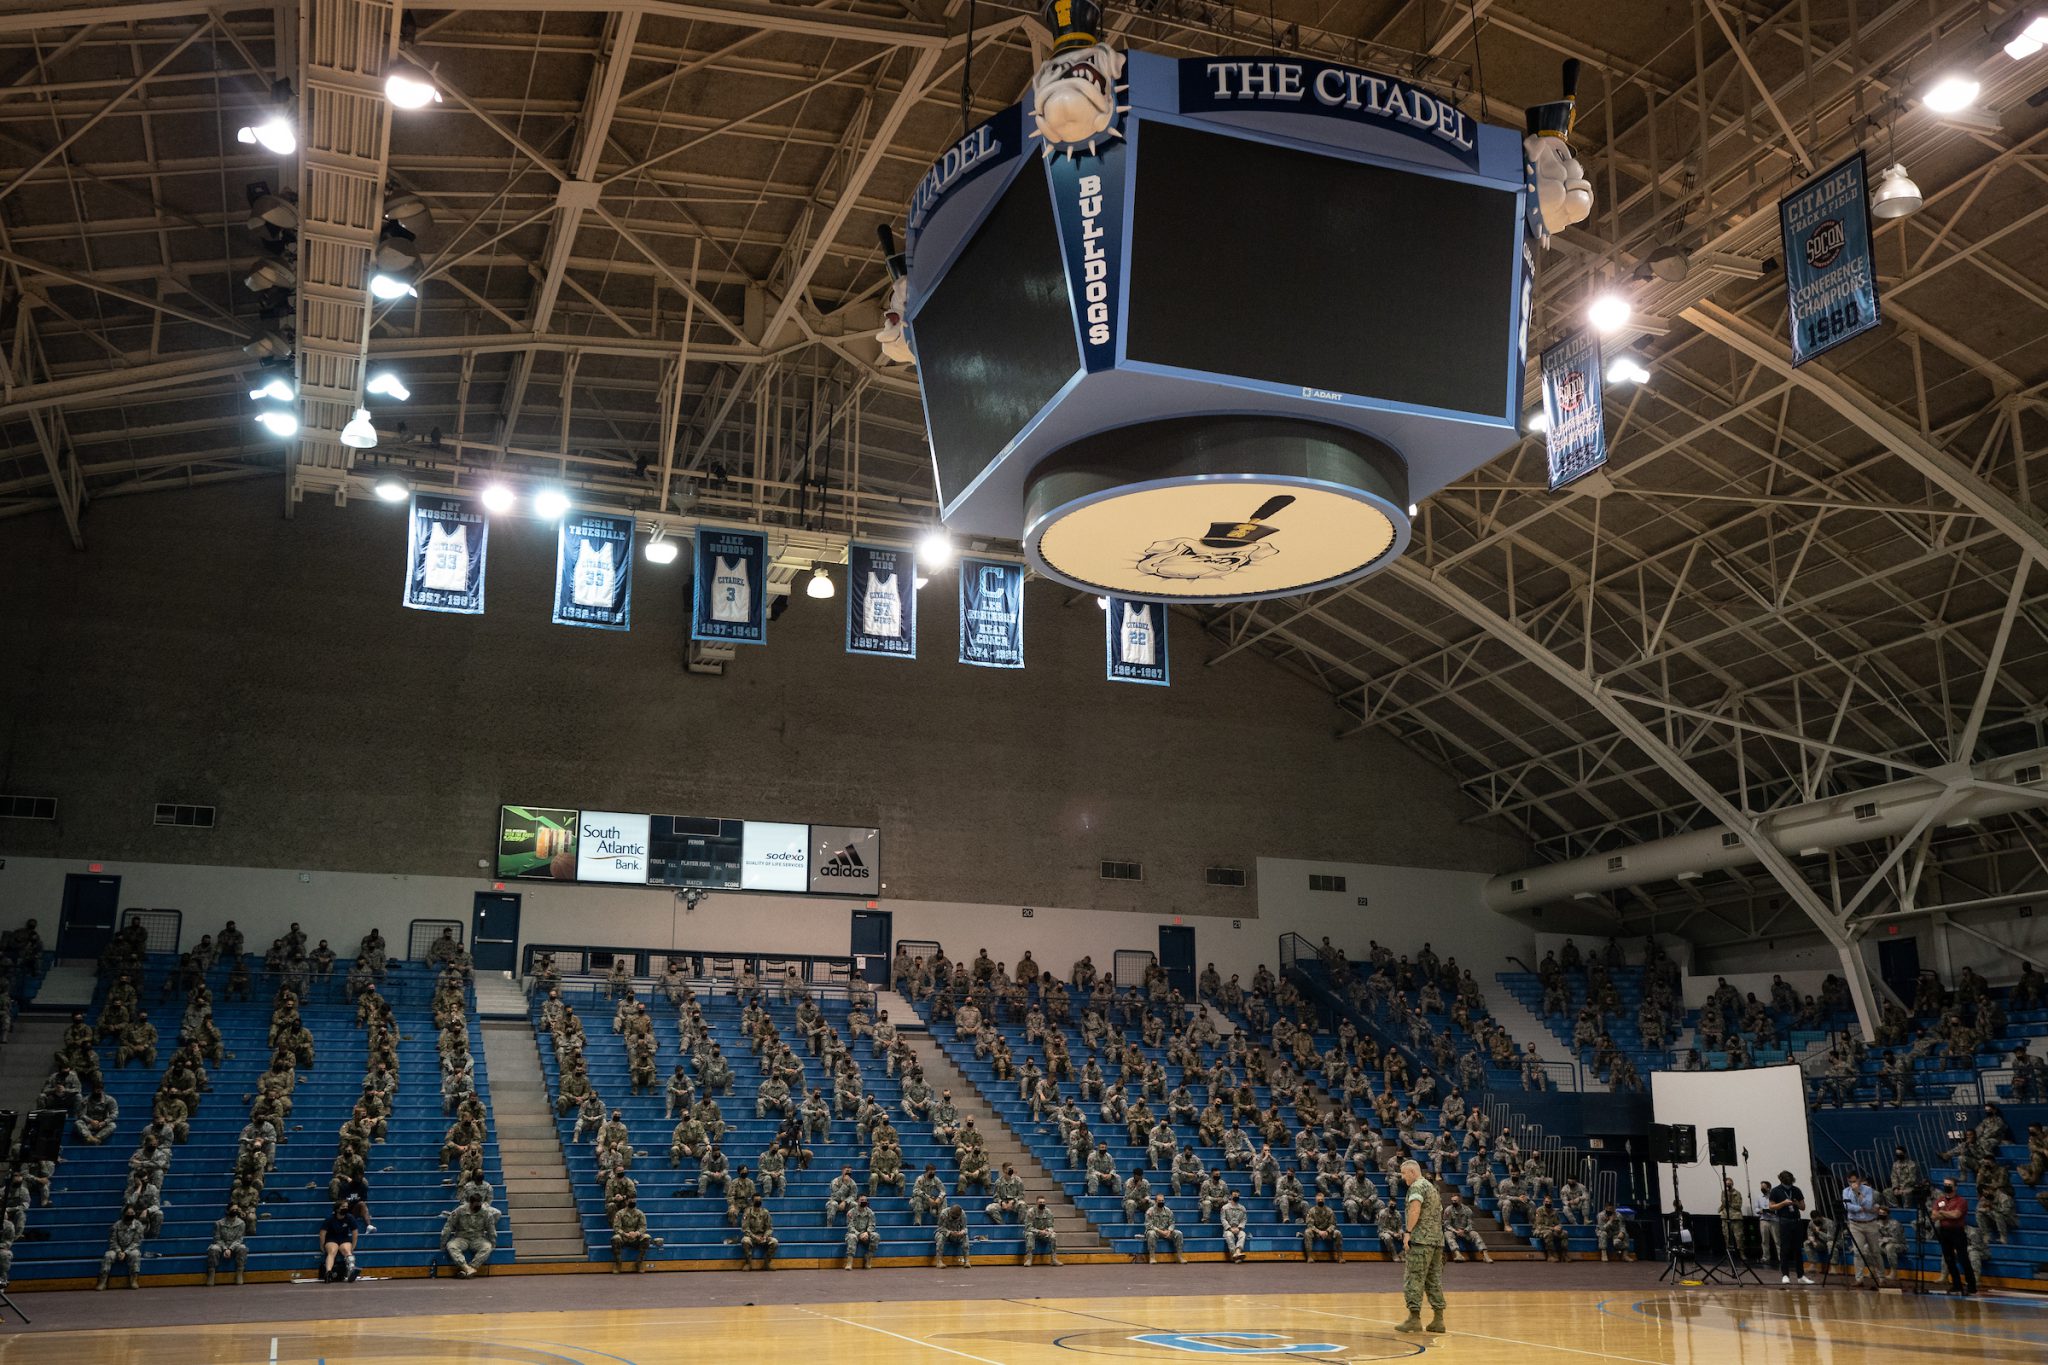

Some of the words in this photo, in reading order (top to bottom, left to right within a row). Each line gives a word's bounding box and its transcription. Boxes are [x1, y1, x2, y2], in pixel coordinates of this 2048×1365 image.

[1207, 62, 1305, 100] THE
[1313, 69, 1473, 151] CITADEL
[1788, 168, 1857, 224] CITADEL
[1790, 212, 1821, 236] TRACK
[1821, 208, 1827, 218] &
[1828, 187, 1858, 213] FIELD
[1806, 219, 1845, 264] SOCON
[1078, 174, 1110, 346] BULLDOGS
[1796, 255, 1864, 303] CONFERENCE
[1797, 272, 1866, 320] CHAMPIONS
[1808, 300, 1858, 348] 1960
[1546, 332, 1593, 371] CITADEL
[1314, 390, 1342, 400] ADART
[441, 502, 460, 512] ART
[417, 508, 482, 523] MUSSELMAN
[569, 525, 626, 540] TRUESDALE
[720, 535, 744, 545] JAKE
[710, 544, 754, 556] BURROWS
[869, 551, 896, 561] BLITZ
[872, 561, 894, 570] KIDS
[717, 576, 745, 587] CITADEL
[980, 566, 1004, 598] C
[726, 587, 736, 601] 3
[982, 600, 1003, 611] LES
[1126, 622, 1150, 631] CITADEL
[976, 634, 1008, 646] COACH
[1129, 631, 1146, 645] 22
[583, 824, 620, 840] South
[597, 840, 645, 855] Atlantic
[766, 850, 804, 861] sodexo
[820, 863, 869, 878] adidas
[1956, 1112, 1967, 1121] 35
